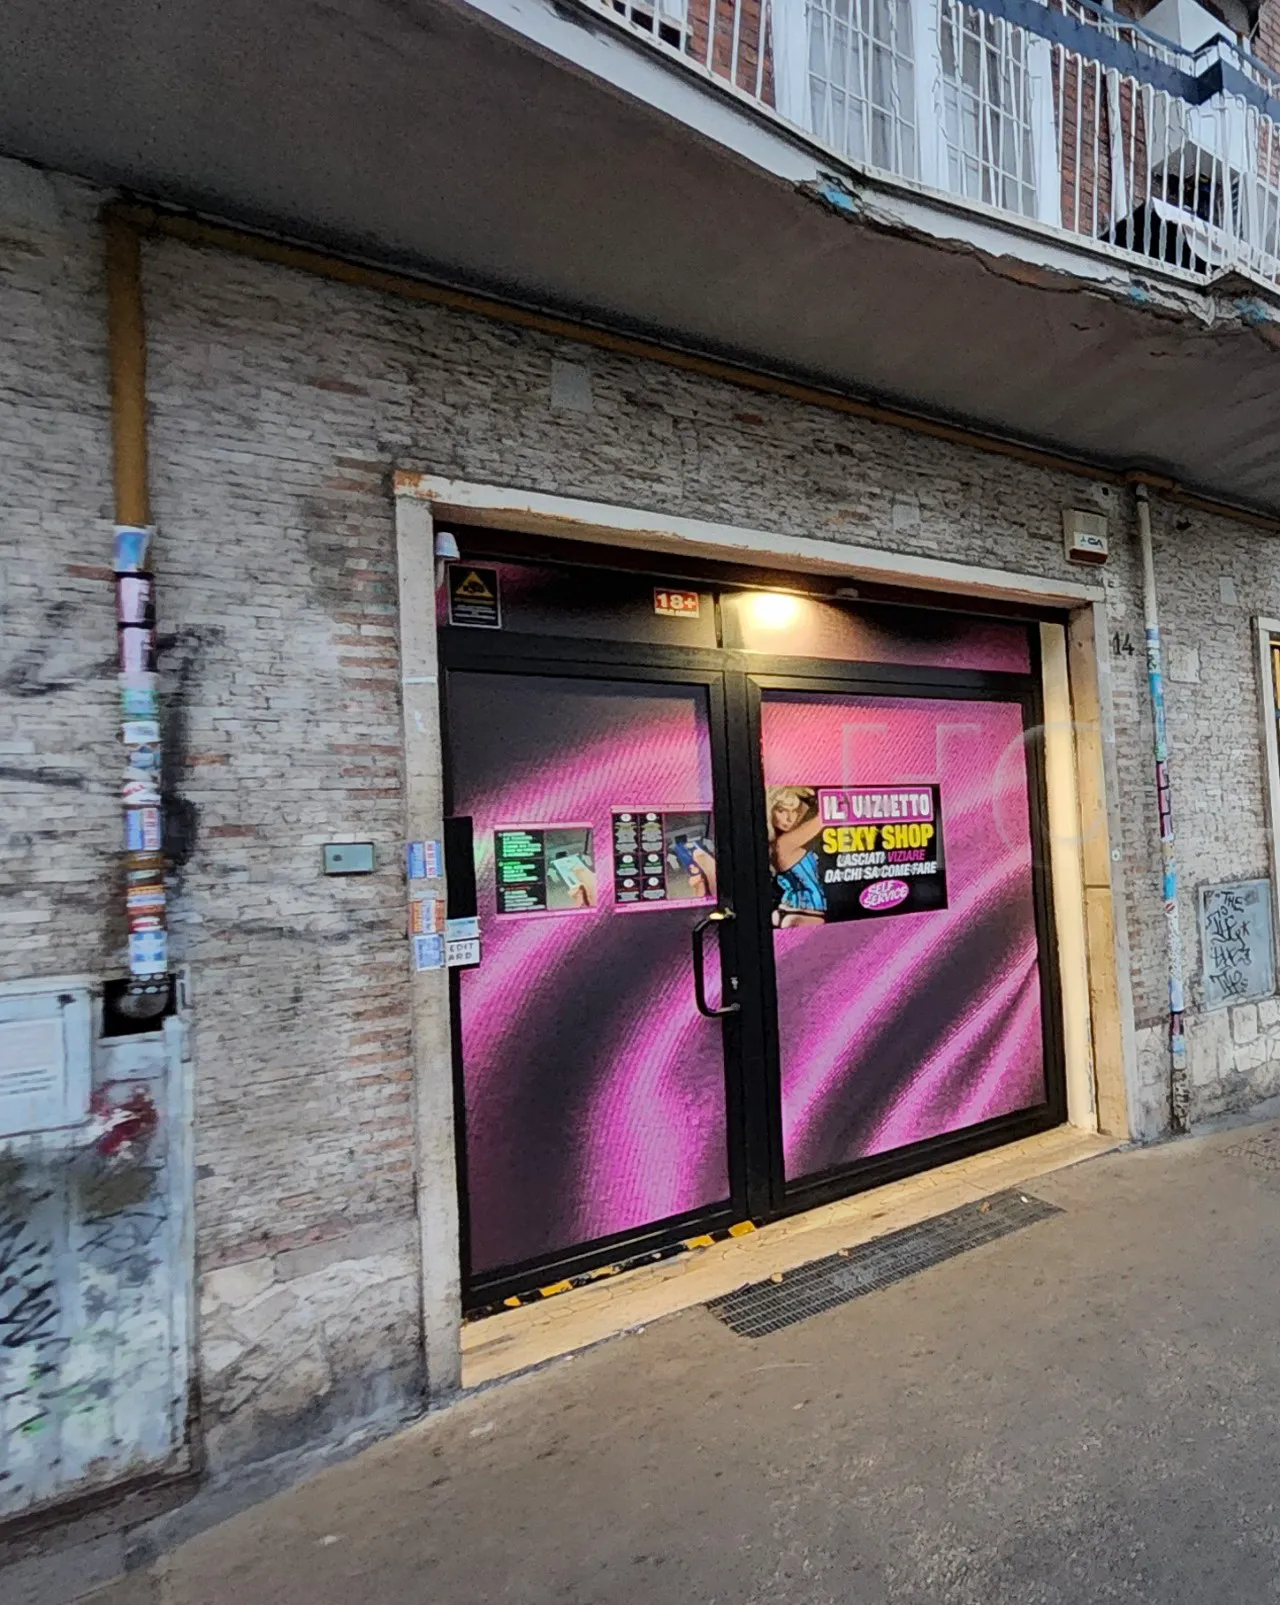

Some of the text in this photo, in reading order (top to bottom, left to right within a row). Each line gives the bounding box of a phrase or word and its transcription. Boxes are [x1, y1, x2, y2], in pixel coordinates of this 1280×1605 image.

[656, 593, 697, 609] 18+
[1112, 631, 1135, 656] 14
[823, 793, 930, 820] IL VIZIETTO
[822, 823, 934, 854] SEXY SHOP
[836, 849, 926, 867] LASCIATI VIZIARE
[824, 861, 937, 883] DA CHI SA COME FARE
